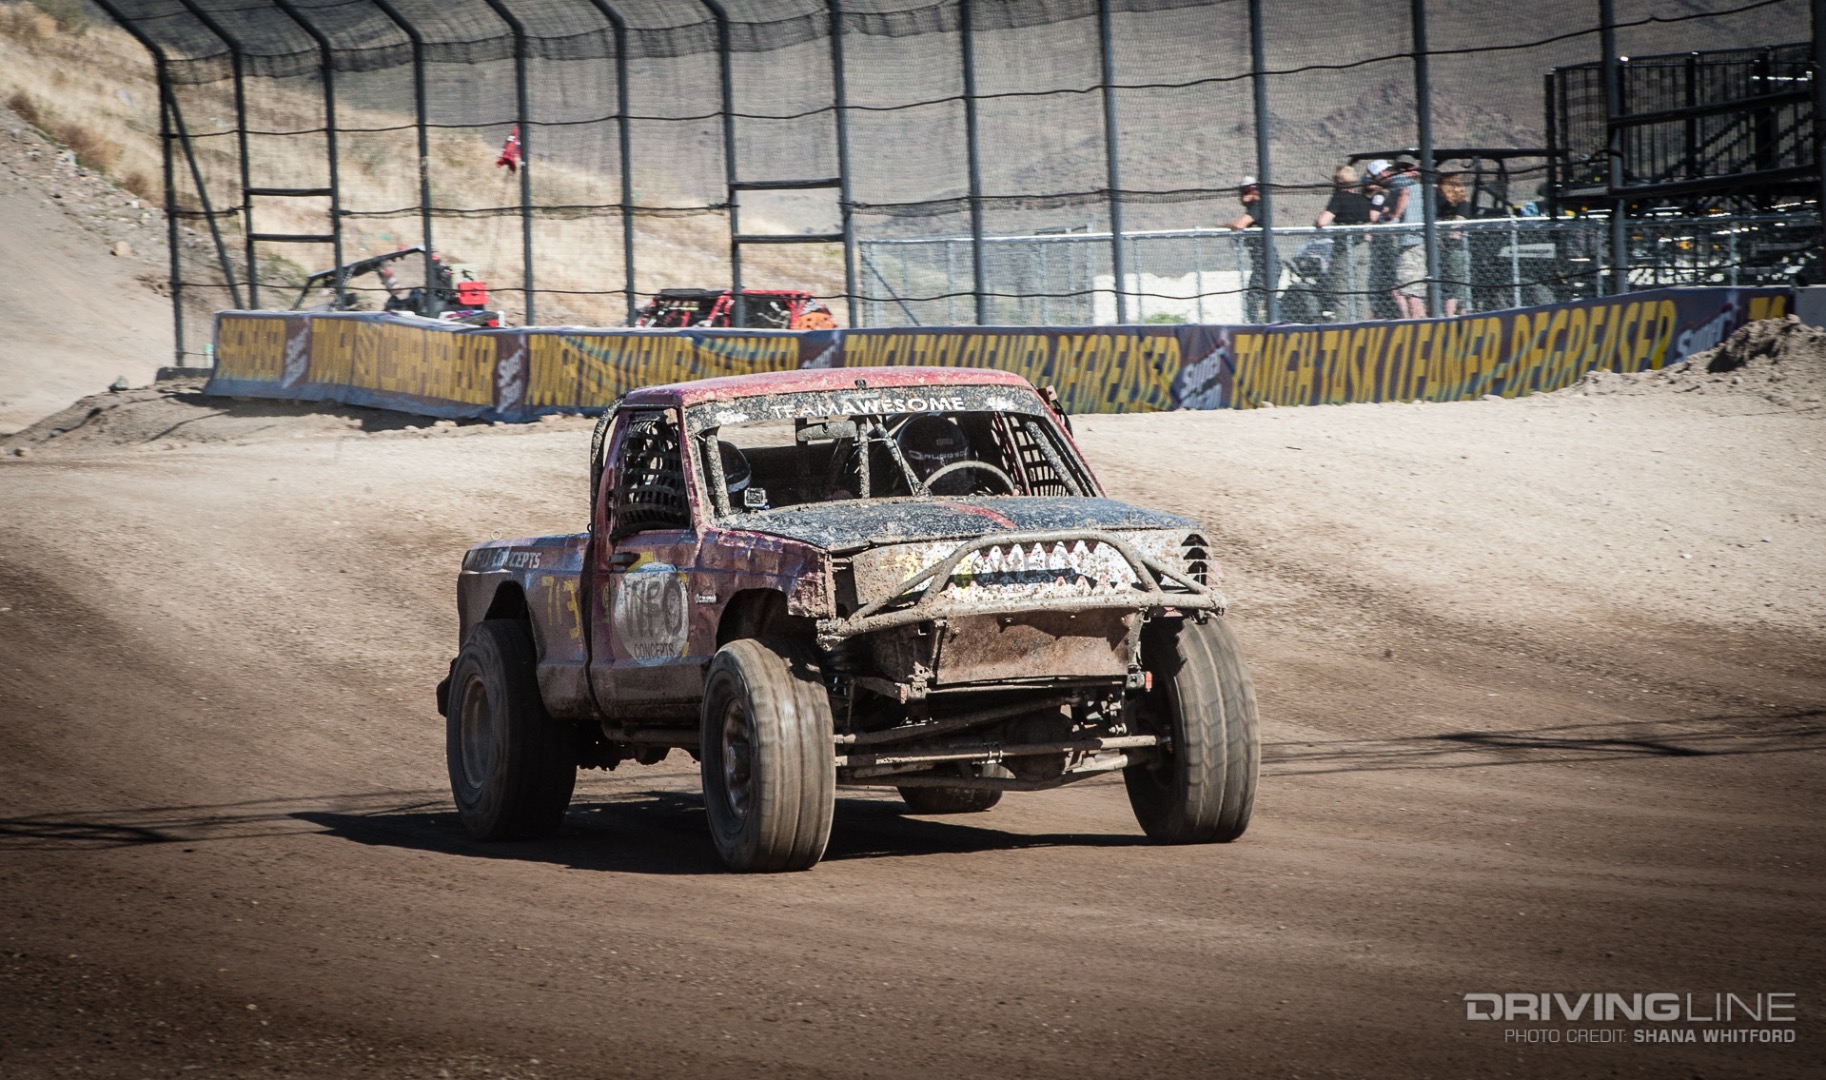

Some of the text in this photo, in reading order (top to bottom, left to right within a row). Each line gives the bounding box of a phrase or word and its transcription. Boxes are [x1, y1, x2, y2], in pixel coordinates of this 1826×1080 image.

[1230, 331, 1319, 409] TOUGH
[1320, 326, 1387, 404] TASK
[633, 642, 675, 659] CONCEPTS
